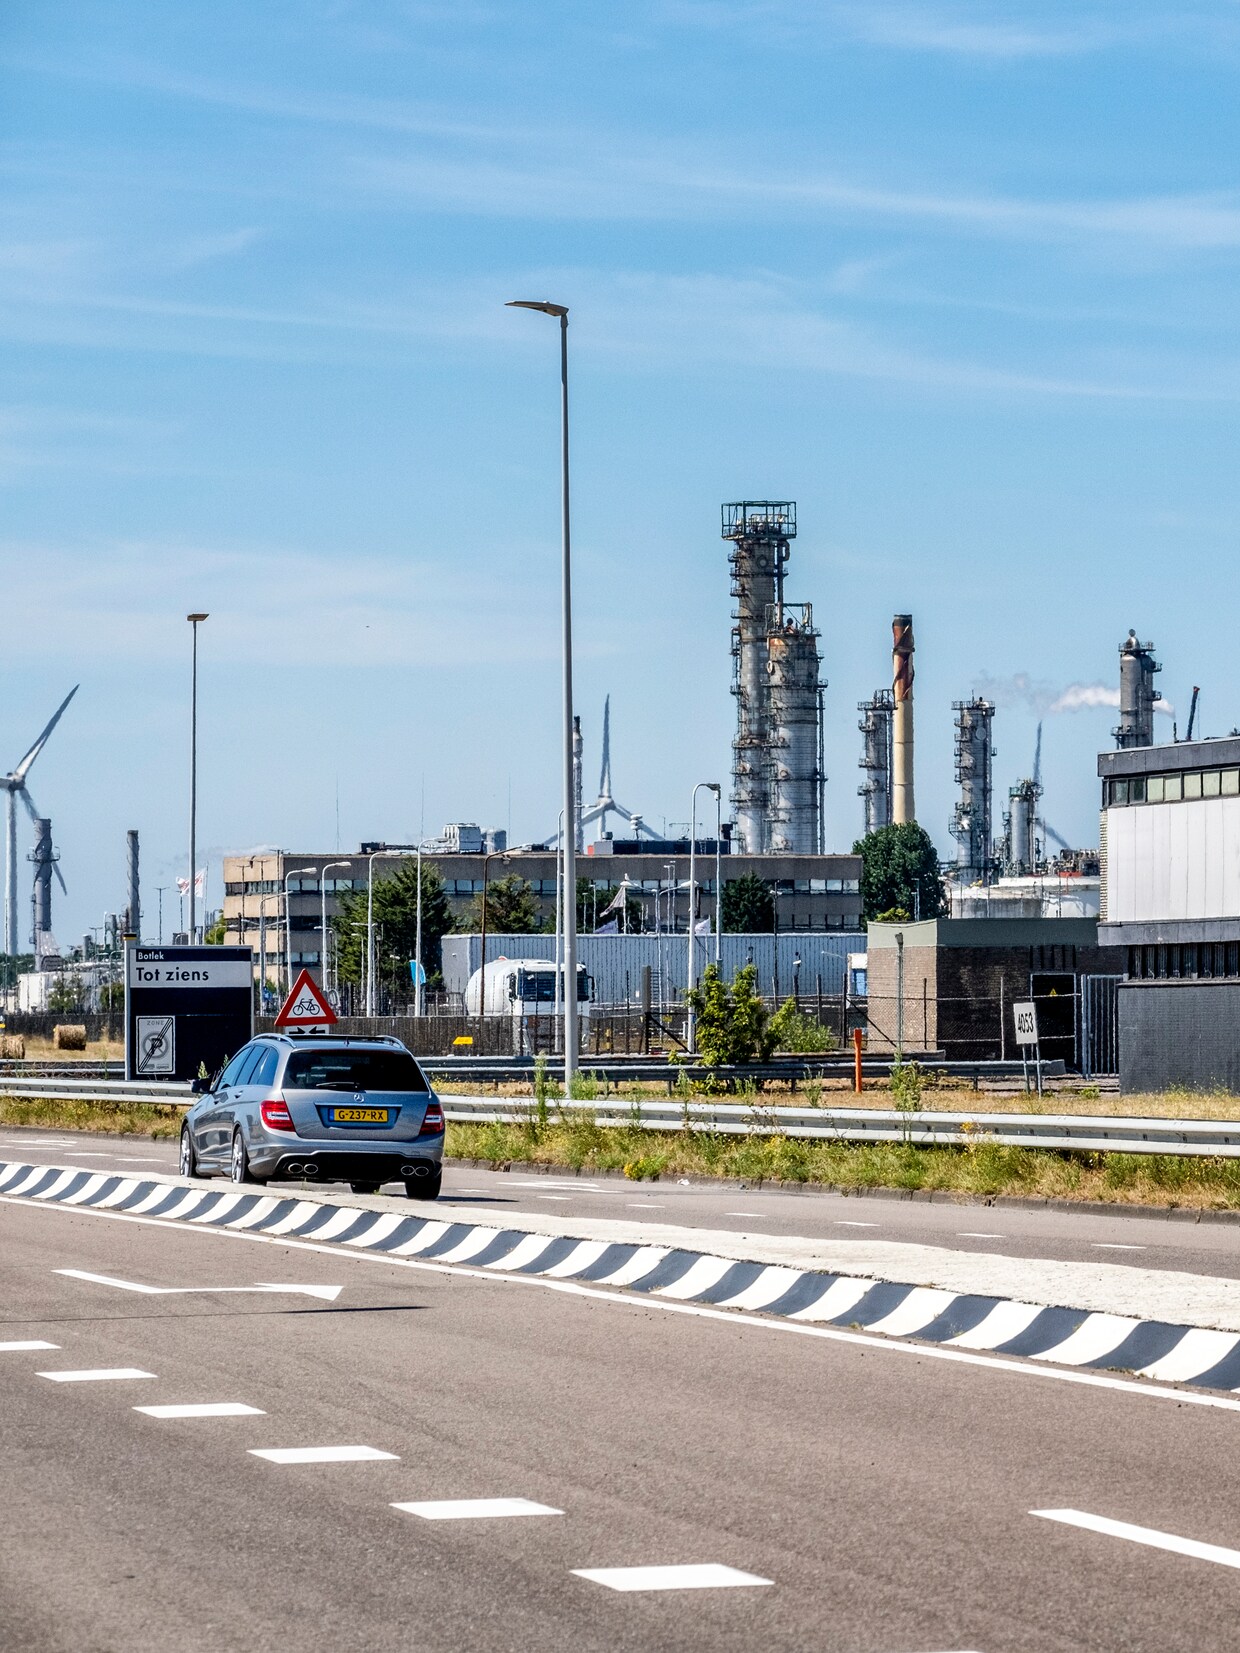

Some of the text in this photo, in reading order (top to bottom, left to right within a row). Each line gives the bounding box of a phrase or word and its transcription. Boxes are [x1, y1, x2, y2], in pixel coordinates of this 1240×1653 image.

[137, 951, 165, 960] Botlek
[136, 967, 209, 981] Tot ziens
[1017, 1012, 1034, 1033] 4053
[338, 1110, 384, 1120] G-237-RX
